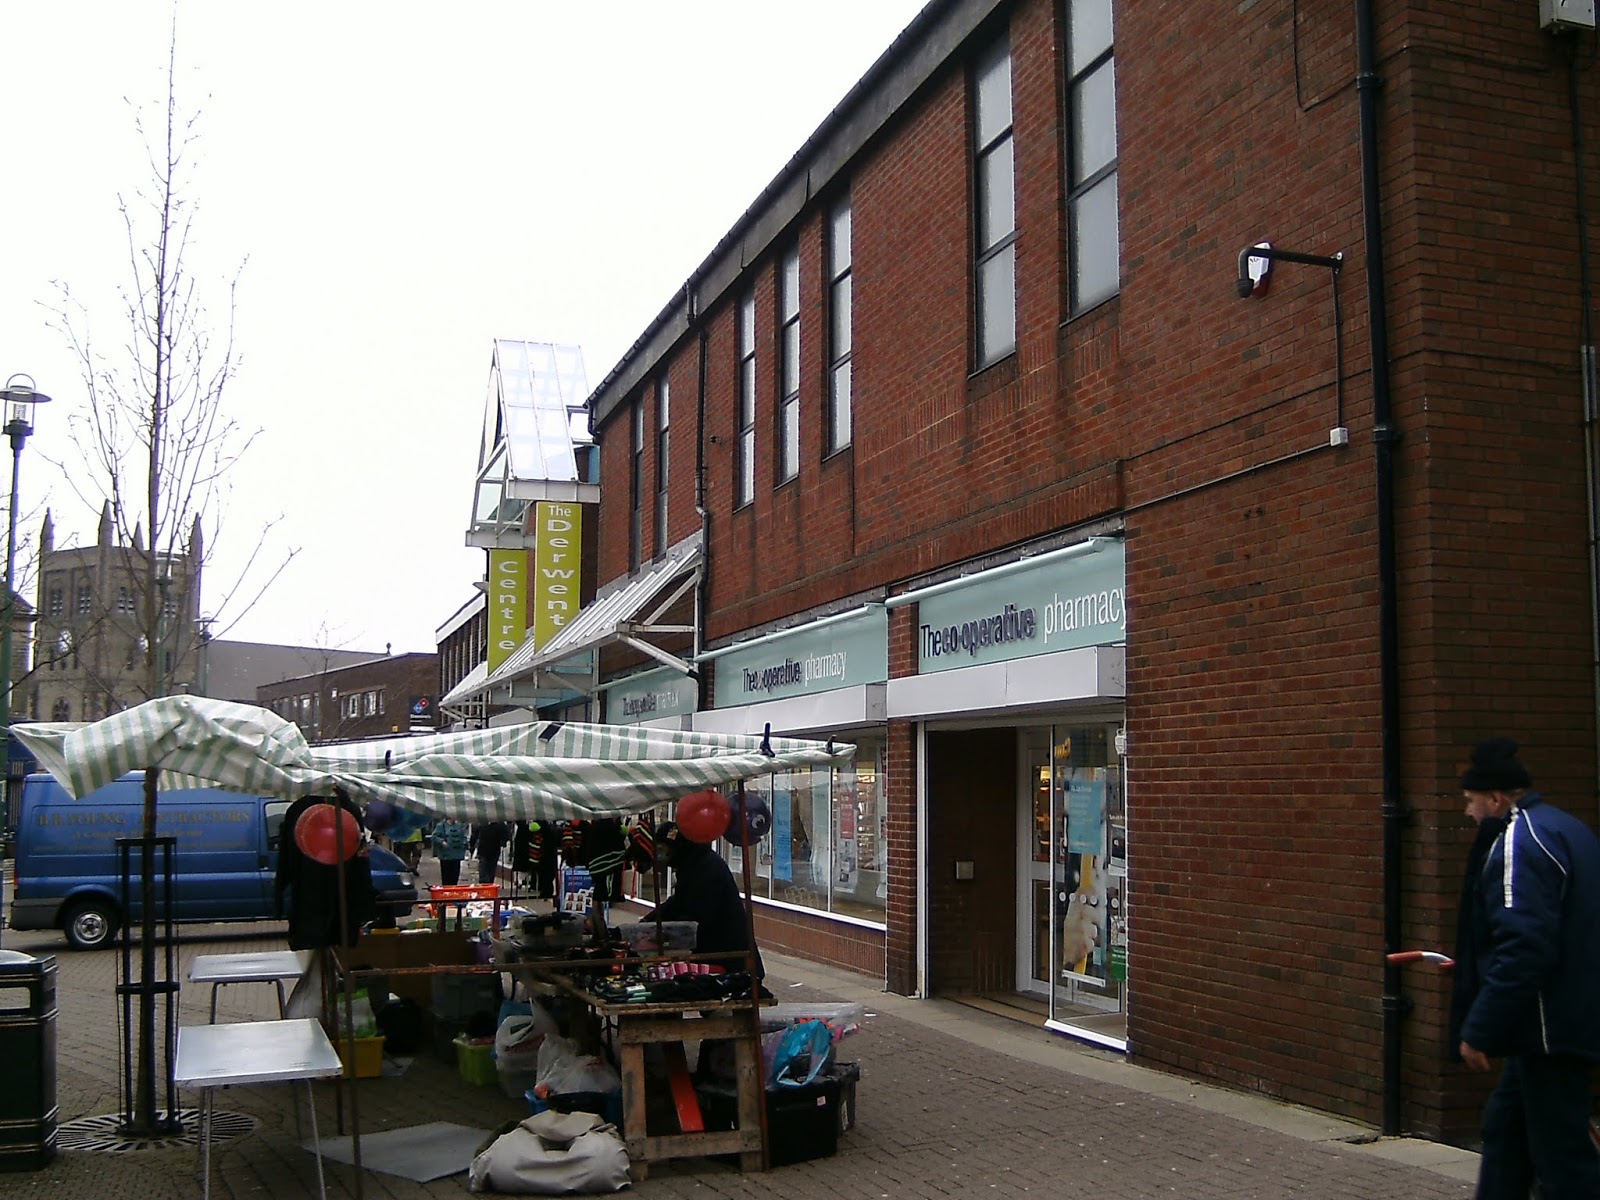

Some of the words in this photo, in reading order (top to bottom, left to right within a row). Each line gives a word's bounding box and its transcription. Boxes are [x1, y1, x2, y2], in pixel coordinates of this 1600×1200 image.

[548, 505, 572, 517] The
[542, 519, 575, 626] Derwent
[498, 561, 519, 650] Centre
[1044, 588, 1126, 643] pharmacy
[805, 653, 847, 686] pharmacy
